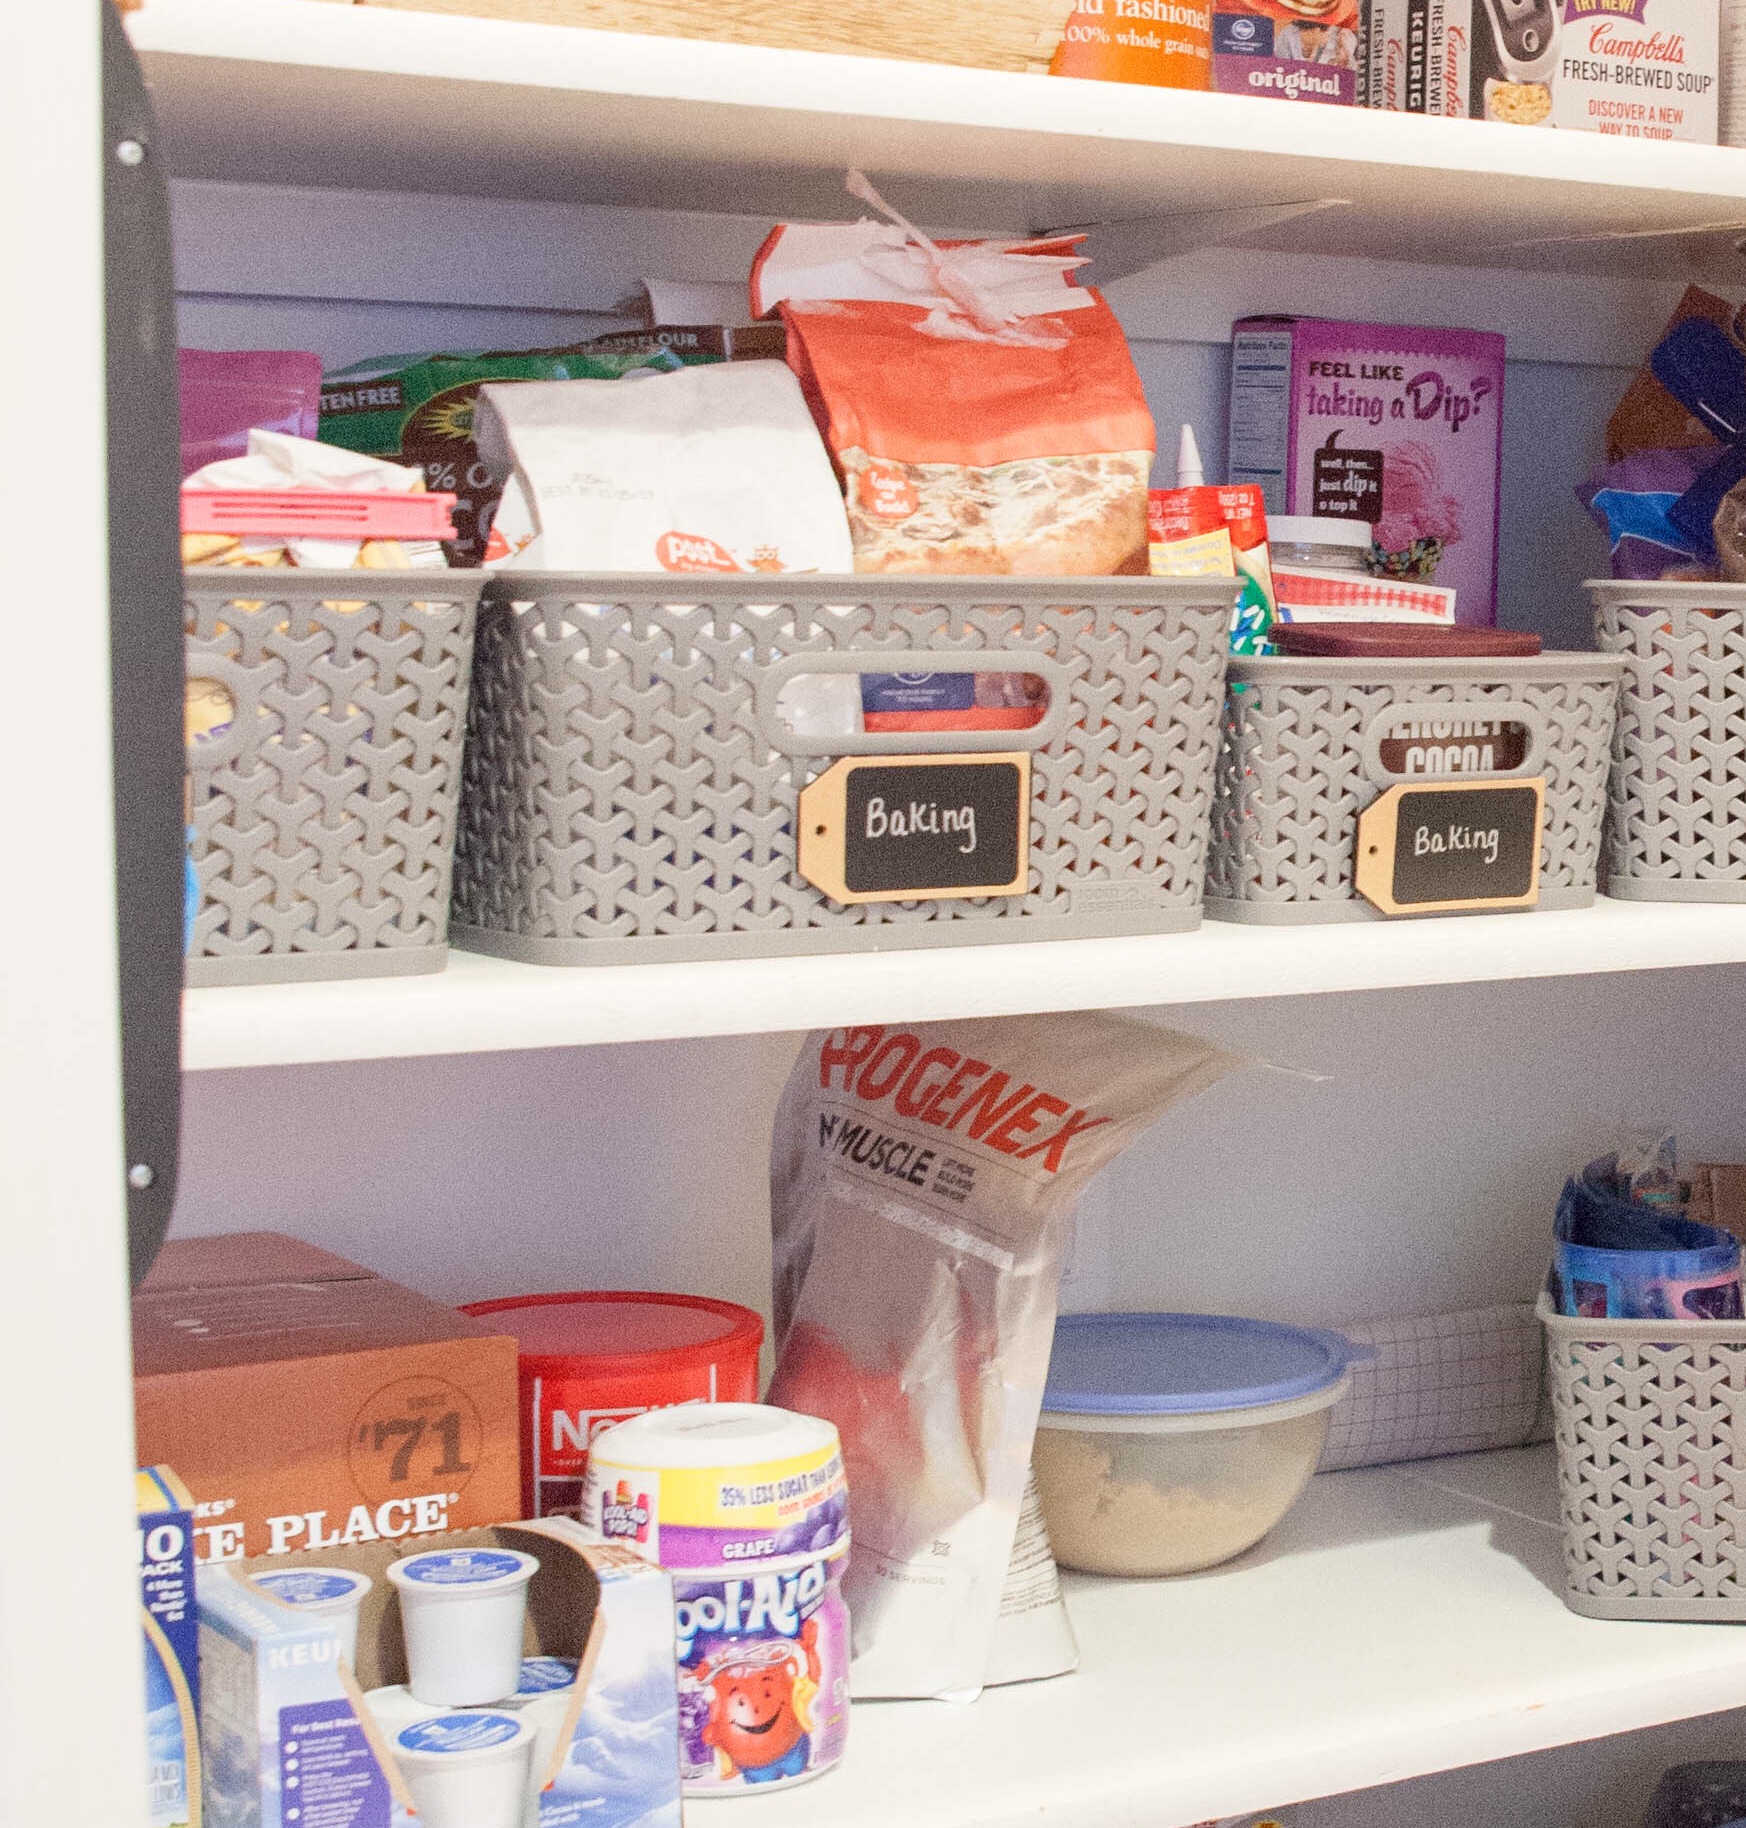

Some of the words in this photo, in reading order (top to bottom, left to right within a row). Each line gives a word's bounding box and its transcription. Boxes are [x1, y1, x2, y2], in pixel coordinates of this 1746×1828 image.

[1116, 29, 1161, 50] whole
[1165, 36, 1194, 58] grain
[1408, 11, 1426, 106] KEURIG
[1588, 23, 1686, 65] Campbell's
[1249, 67, 1342, 100] original
[1563, 58, 1673, 90] FRESH-BREWED
[1676, 72, 1714, 94] SOUP
[1588, 99, 1646, 121] DISCOVER
[1659, 106, 1684, 124] NEW
[1309, 360, 1355, 380] FEEL
[1360, 363, 1405, 382] LIKE
[320, 392, 353, 412] TEN
[357, 385, 399, 408] FREE
[1306, 381, 1384, 426] taking
[1405, 371, 1492, 433] Dip?
[1319, 478, 1342, 494] just
[1343, 471, 1366, 497] dip
[1406, 743, 1494, 773] COCOA
[865, 797, 977, 854] Baking
[1415, 824, 1499, 865] Baking
[358, 1412, 472, 1483] '71
[722, 1485, 746, 1508] 35%
[750, 1482, 774, 1504] LESS
[778, 1474, 809, 1501] SUGAR
[266, 1493, 450, 1556] PLACE
[722, 1538, 775, 1560] GRAPE
[676, 1560, 826, 1639] ool-Aid
